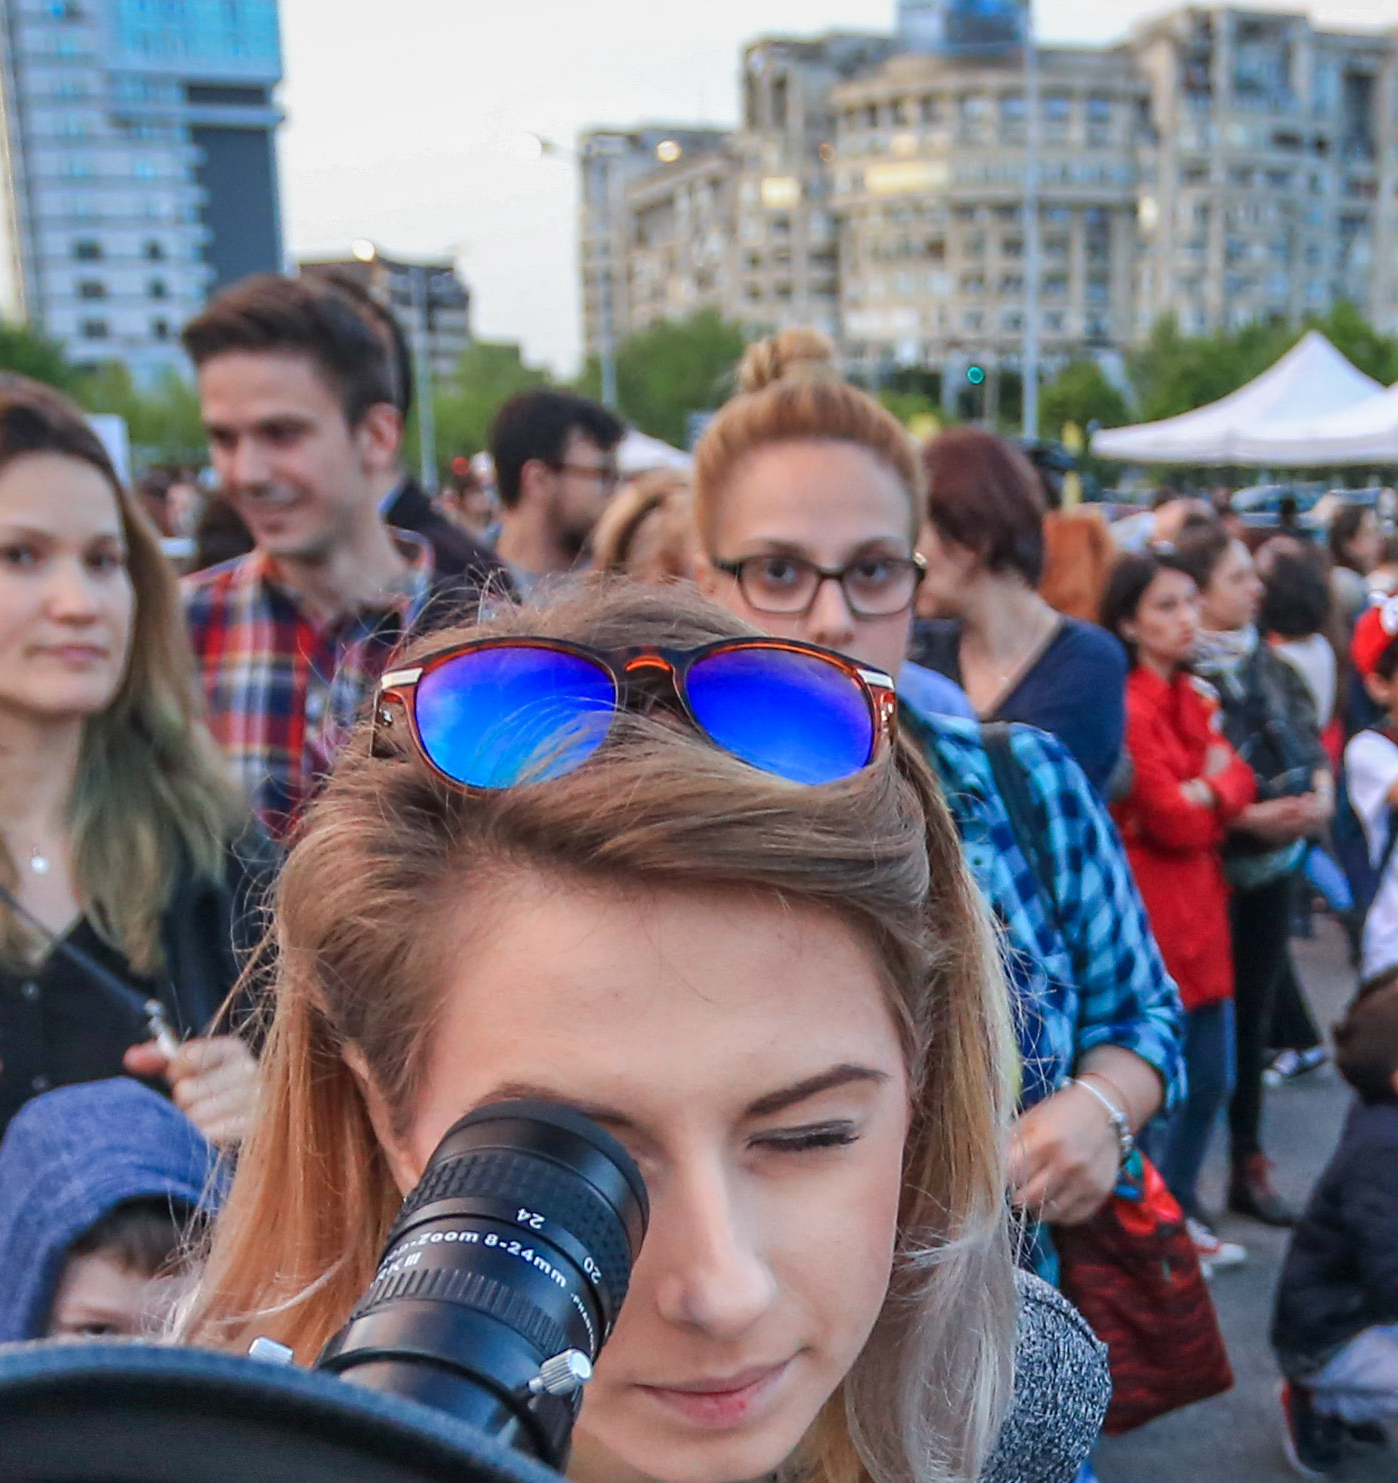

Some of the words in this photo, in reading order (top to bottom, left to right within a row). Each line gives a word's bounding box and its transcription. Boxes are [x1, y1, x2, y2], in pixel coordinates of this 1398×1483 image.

[517, 1208, 545, 1229] 24
[484, 1233, 567, 1288] 8-24mm
[584, 1257, 602, 1284] 20
